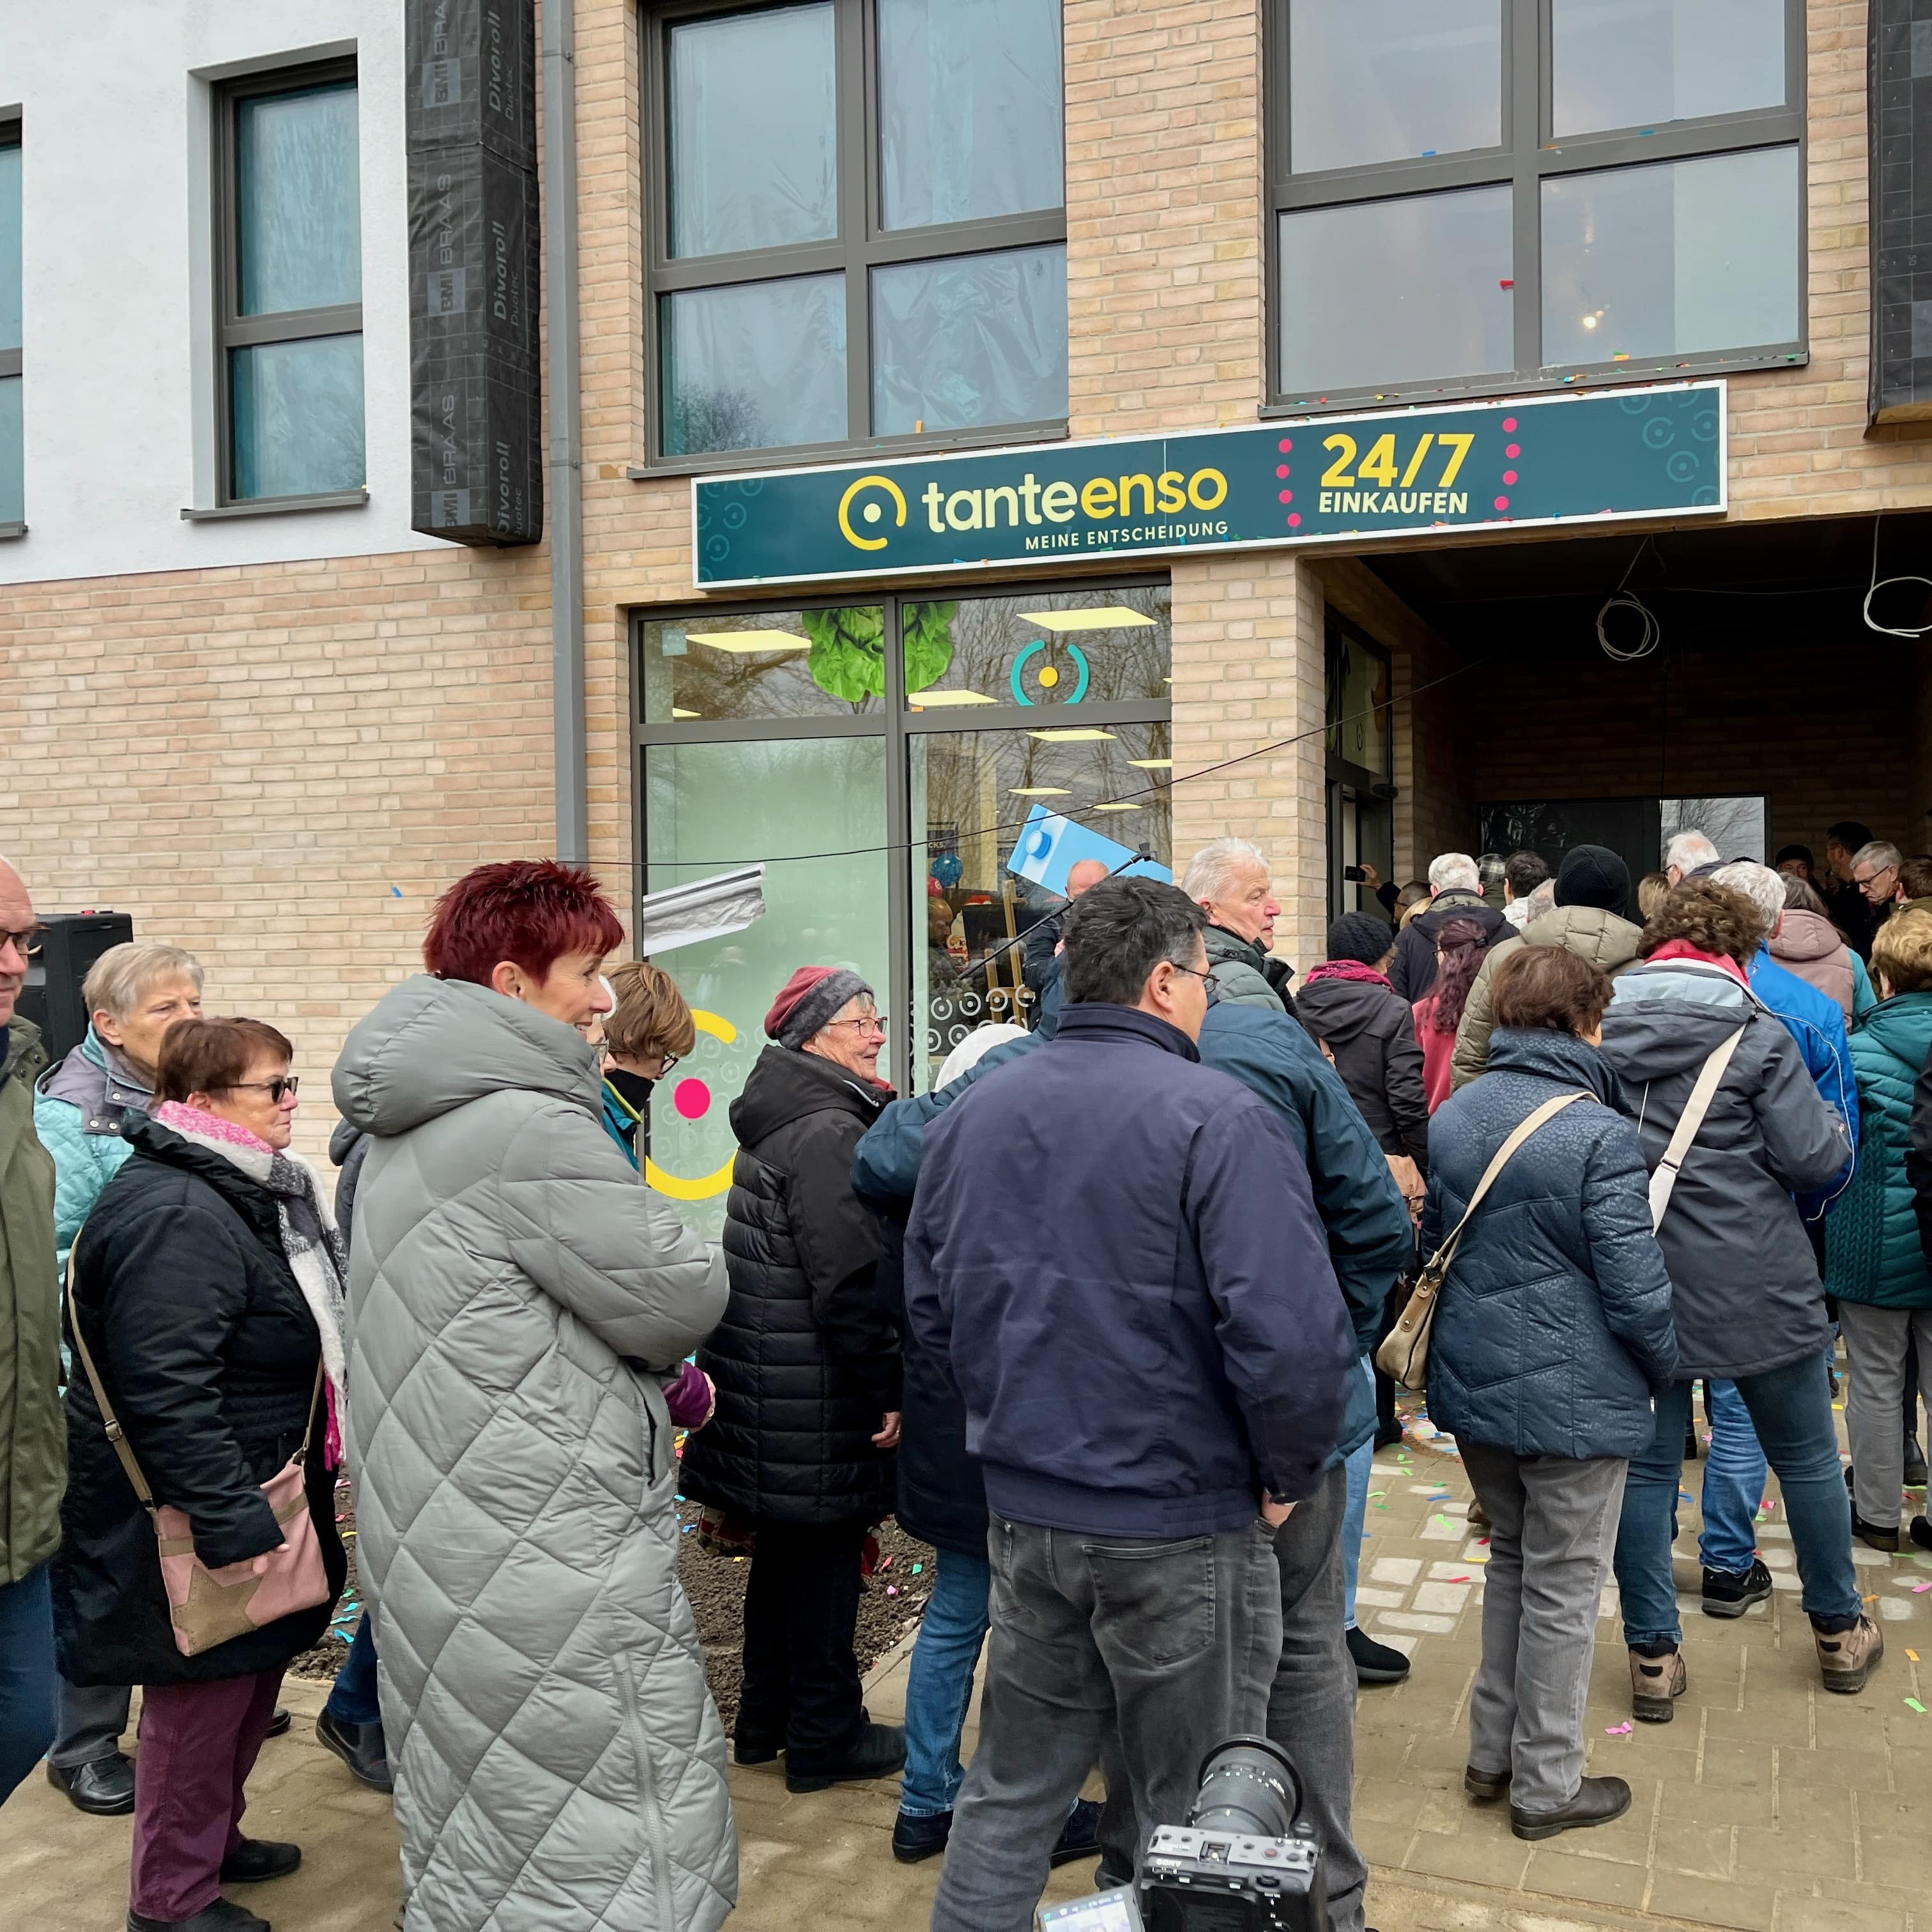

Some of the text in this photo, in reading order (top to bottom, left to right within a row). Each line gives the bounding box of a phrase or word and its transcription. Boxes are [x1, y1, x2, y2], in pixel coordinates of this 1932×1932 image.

[487, 10, 502, 113] Divoroll
[438, 173, 454, 312] BMI BRAAS
[491, 219, 507, 320] Divoroll
[510, 271, 519, 327] Duotec
[441, 394, 457, 485] BRAAS
[1321, 433, 1476, 488] 24/7
[496, 440, 510, 537] Divoroll
[921, 467, 1229, 533] tanteenso
[1319, 492, 1468, 514] EINKAUFEN
[1025, 520, 1229, 550] MEINE ENTSCHEIDUNG
